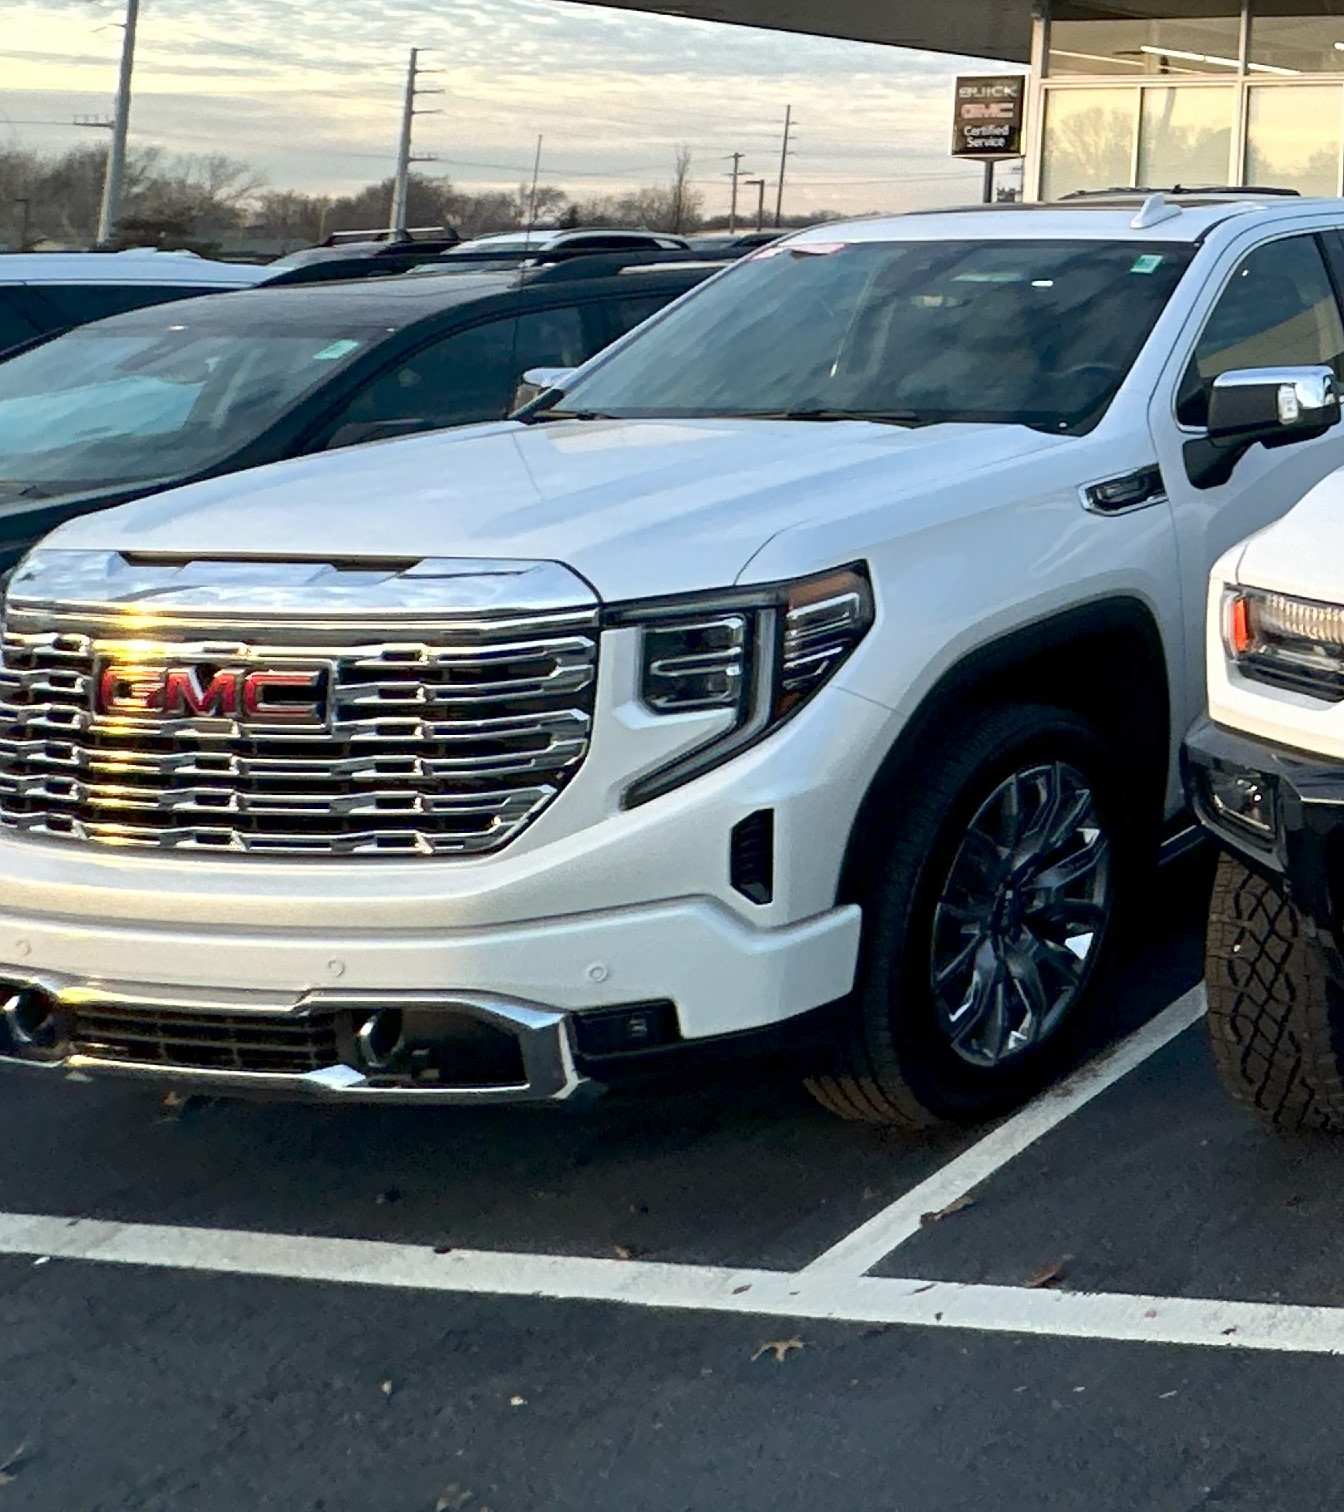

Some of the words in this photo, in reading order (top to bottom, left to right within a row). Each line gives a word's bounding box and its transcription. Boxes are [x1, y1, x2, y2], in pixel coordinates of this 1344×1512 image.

[959, 85, 1018, 98] BUICK
[961, 102, 1014, 119] GMC
[963, 124, 1010, 137] Certified
[966, 136, 1006, 148] Service
[100, 666, 319, 718] GMC
